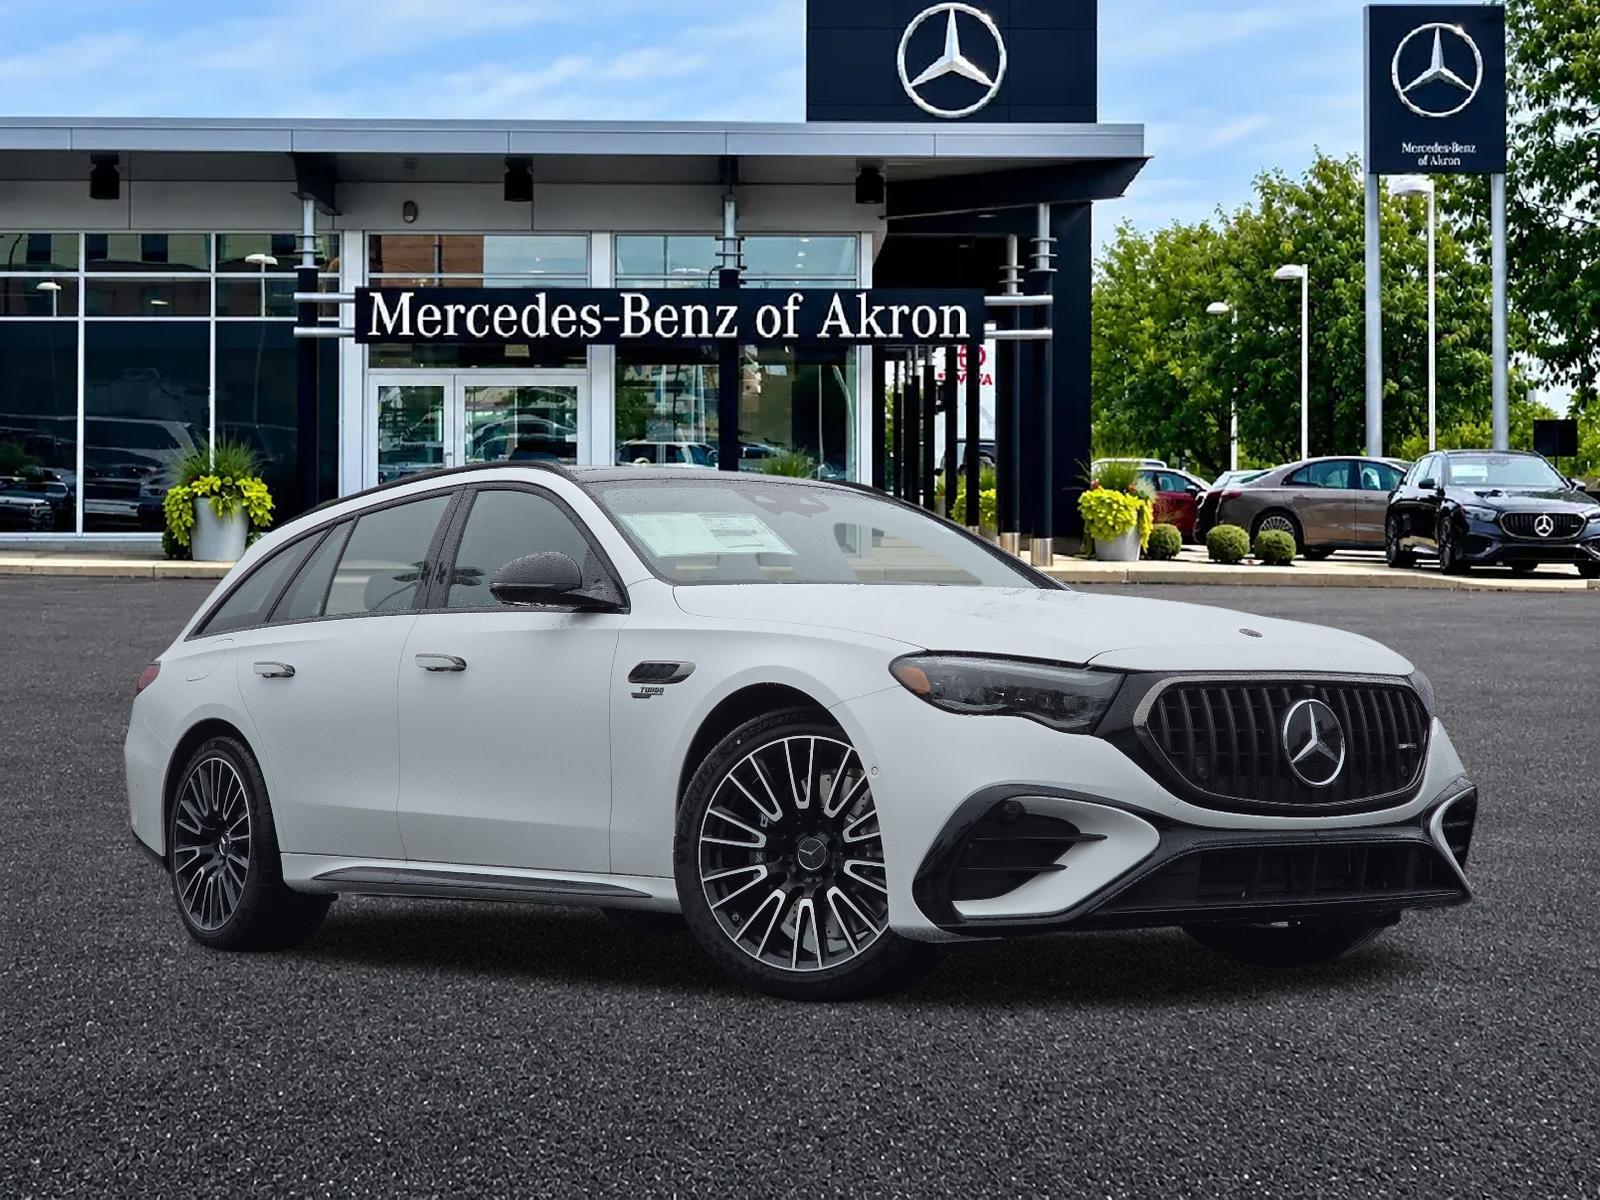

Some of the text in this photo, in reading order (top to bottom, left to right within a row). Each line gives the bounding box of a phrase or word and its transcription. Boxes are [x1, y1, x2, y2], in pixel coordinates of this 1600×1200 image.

[1418, 154, 1461, 166] of Akron
[367, 291, 970, 339] Mercedes-Benz of Akron
